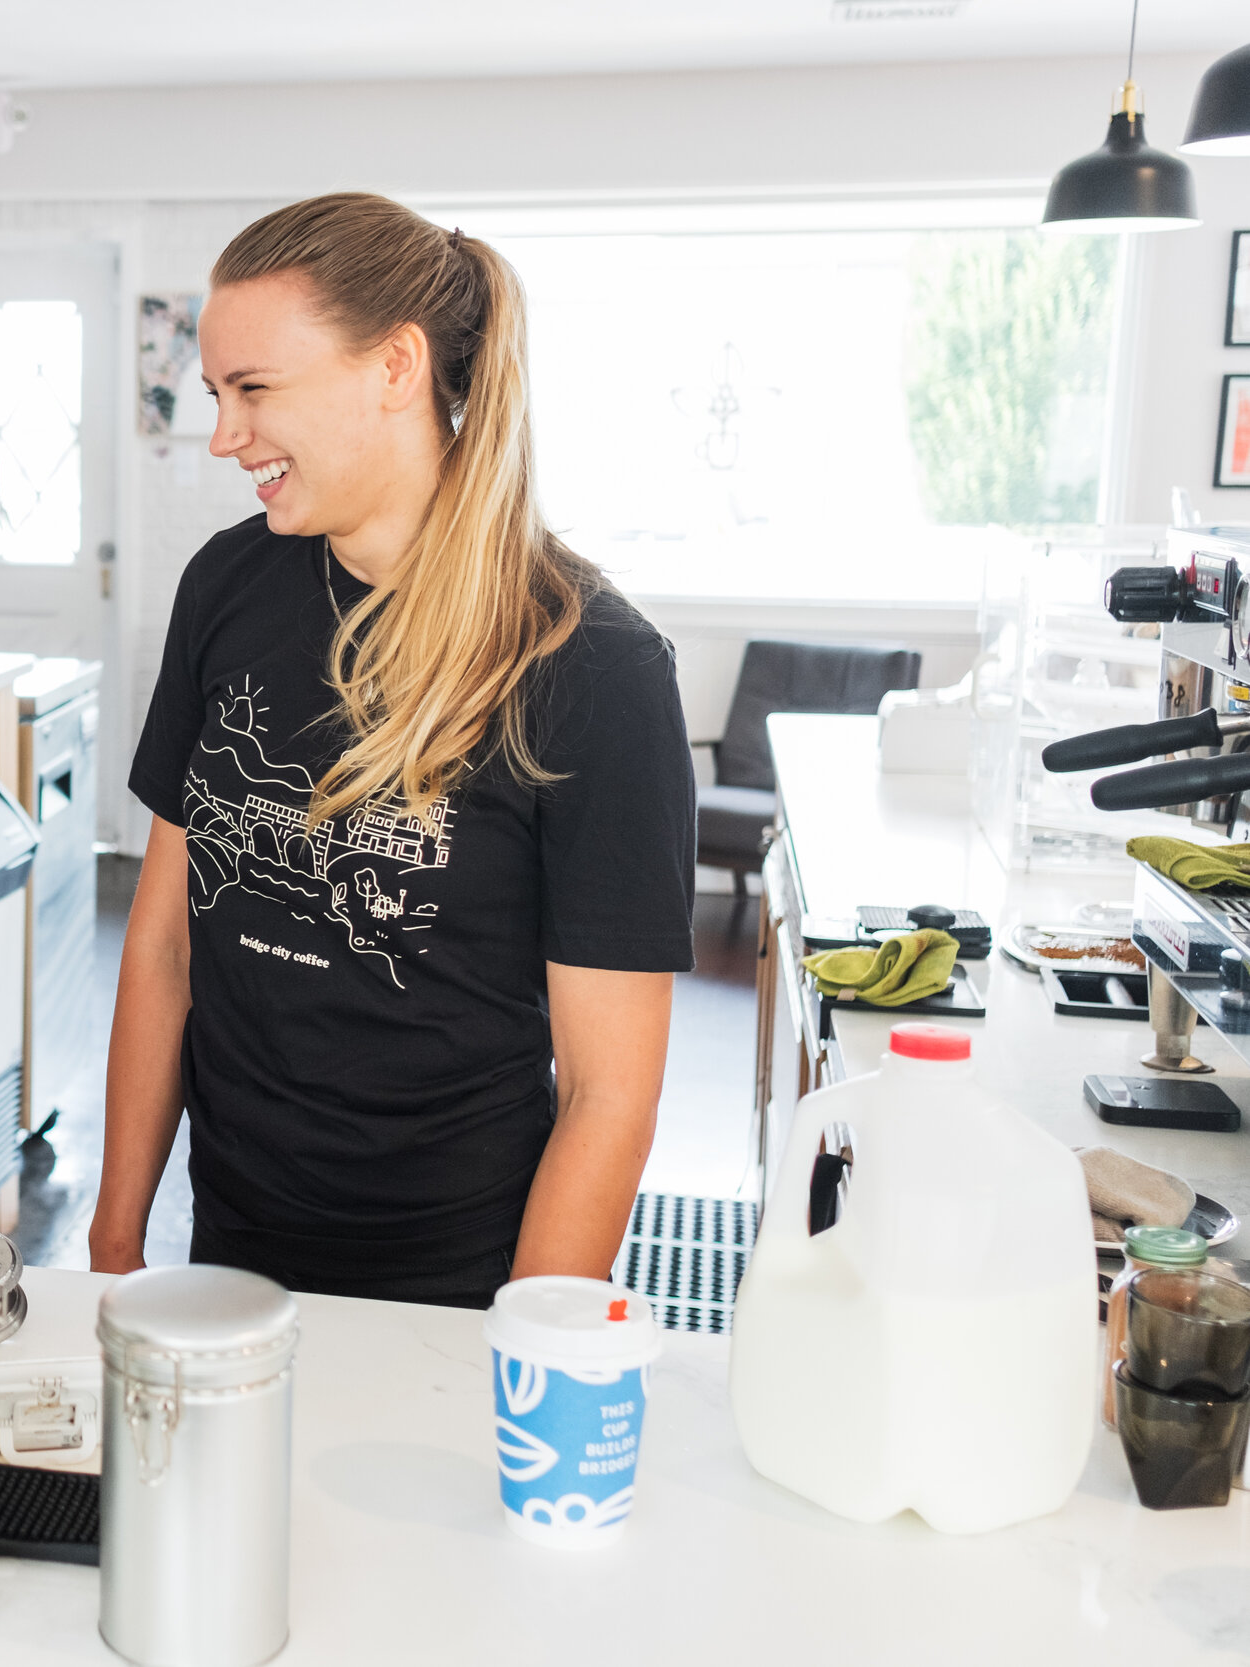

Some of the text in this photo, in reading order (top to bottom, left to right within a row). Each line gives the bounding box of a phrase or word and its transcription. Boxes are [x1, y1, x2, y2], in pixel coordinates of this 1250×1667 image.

[240, 934, 330, 968] bridge city coffee
[600, 1400, 635, 1419] THIS
[602, 1420, 629, 1438] CUP
[586, 1434, 636, 1457] BUILDS
[579, 1451, 636, 1475] BRIDGES
